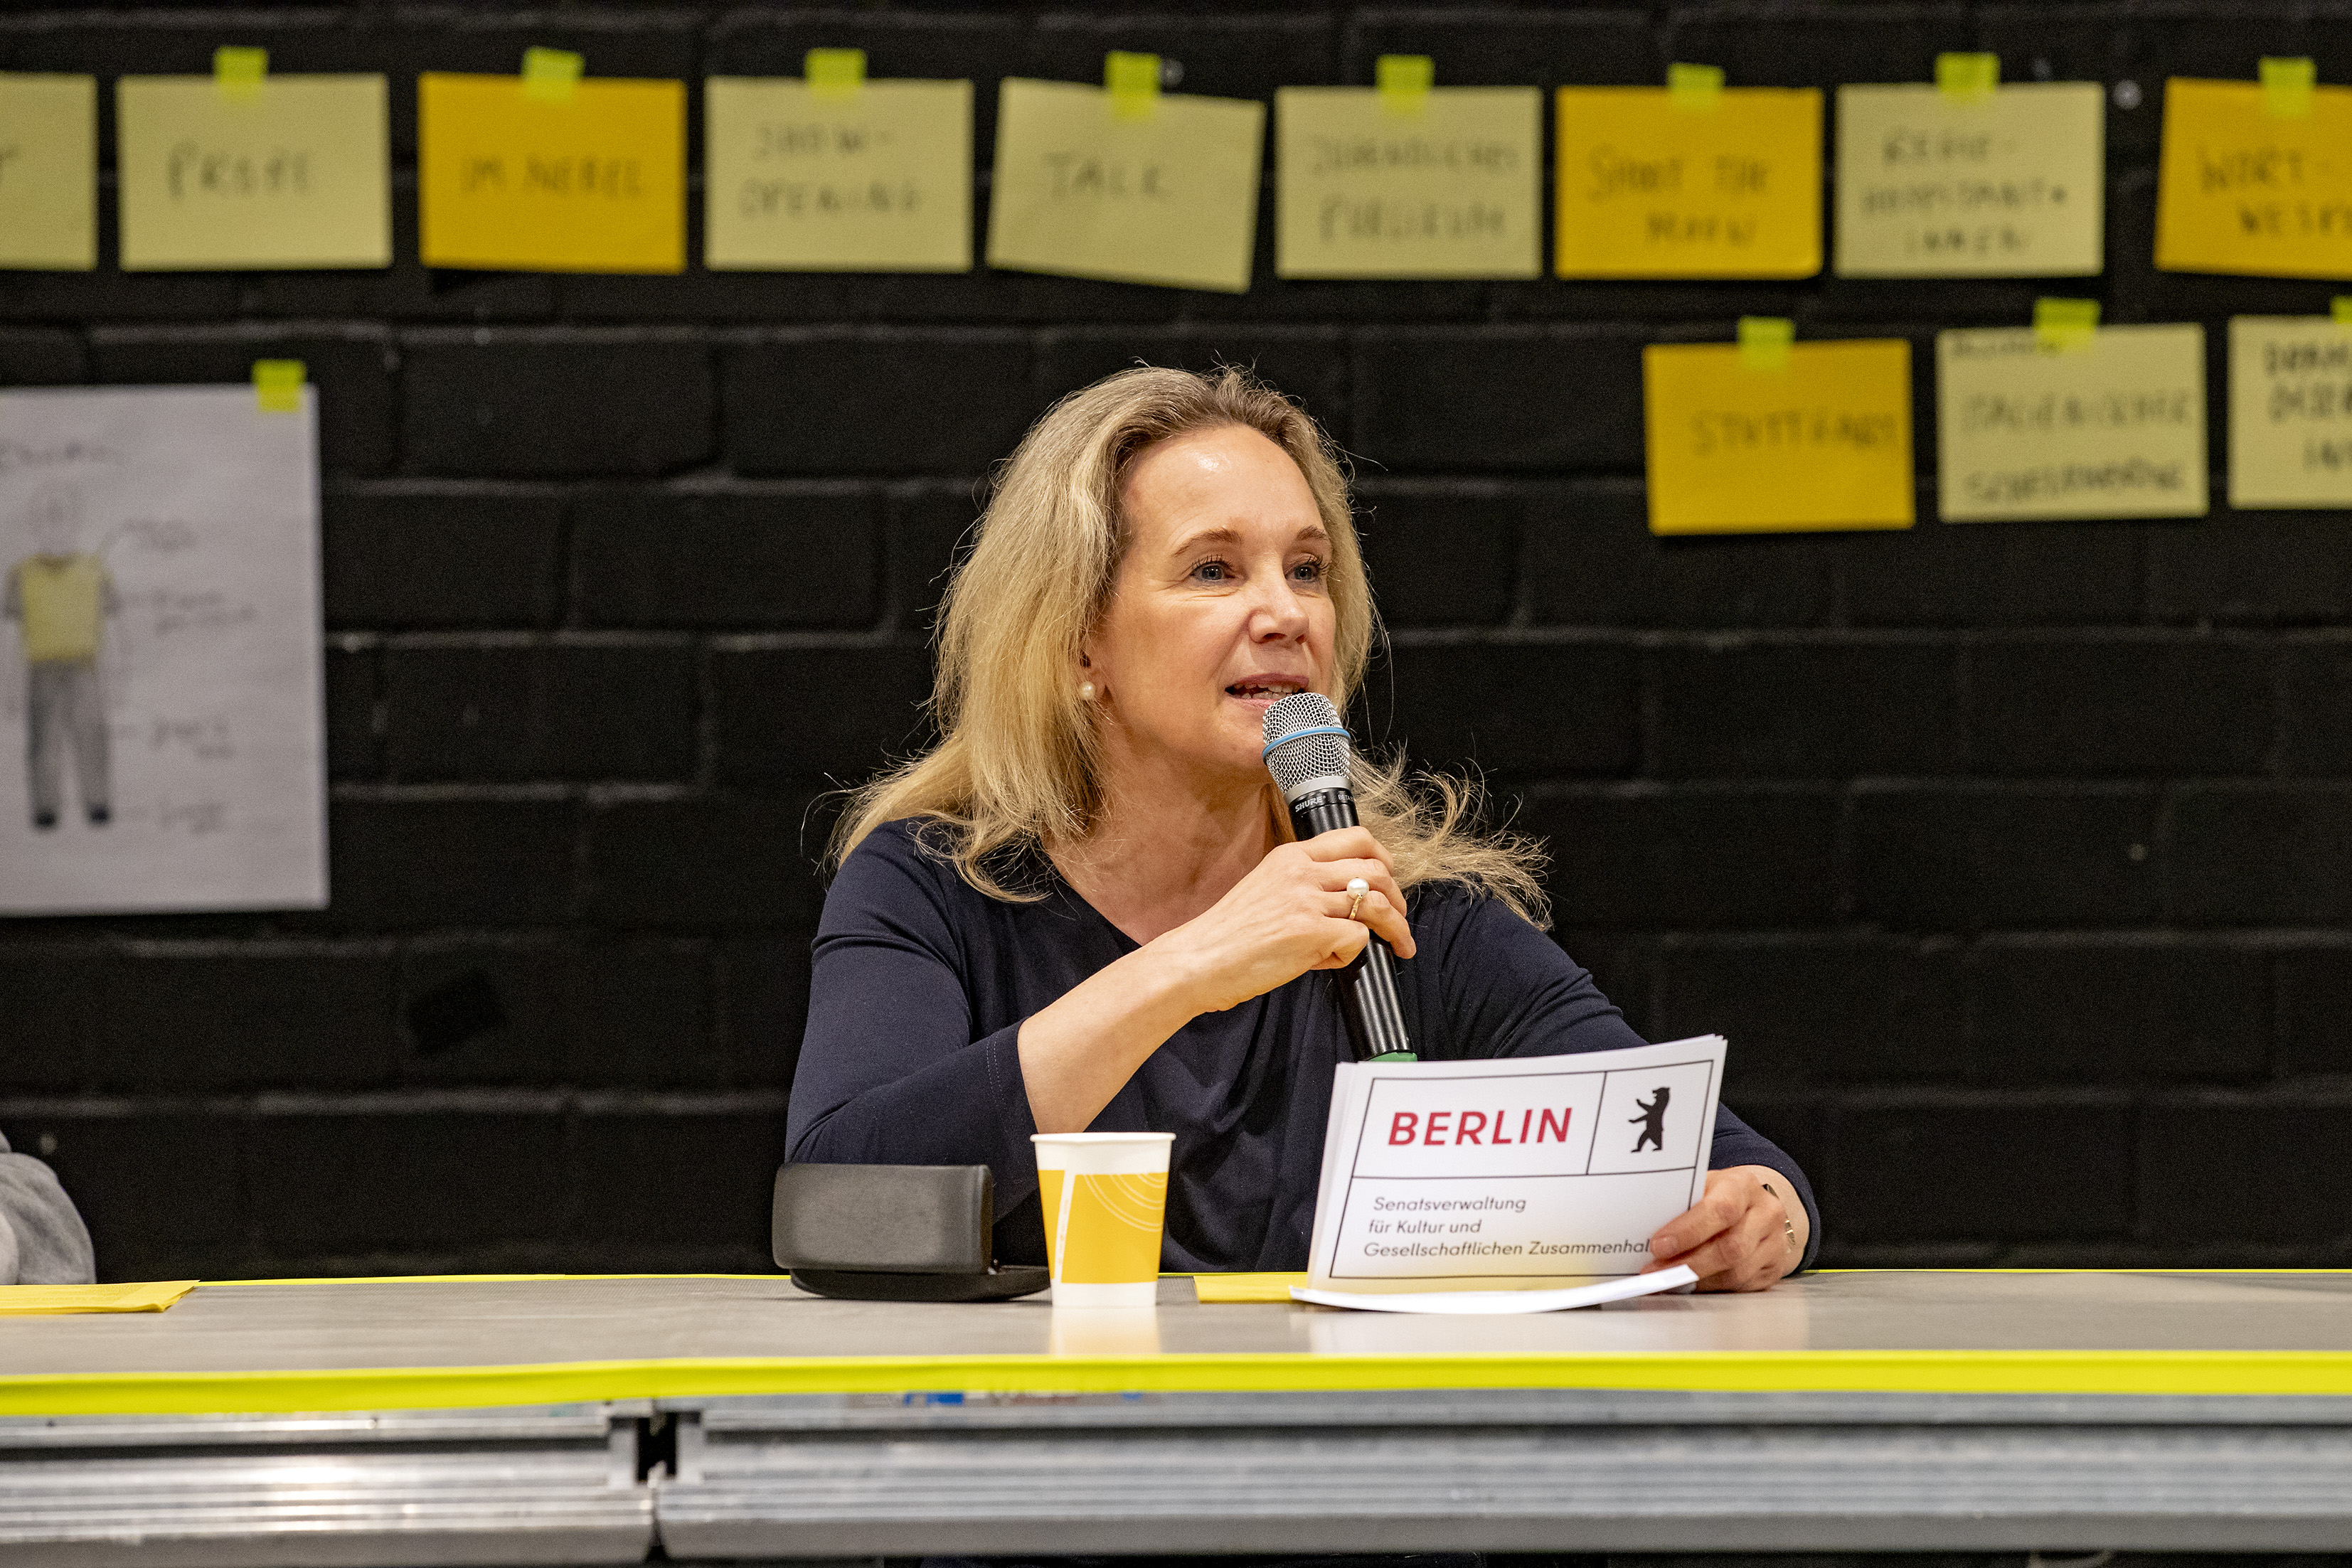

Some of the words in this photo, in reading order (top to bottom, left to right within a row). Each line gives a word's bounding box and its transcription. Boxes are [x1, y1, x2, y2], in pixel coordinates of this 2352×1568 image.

[1042, 150, 1172, 199] TALK
[1295, 796, 1323, 813] SHURE
[1388, 1107, 1572, 1146] BERLIN
[1373, 1196, 1526, 1213] Senatsverwaltung
[1368, 1219, 1392, 1234] für
[1397, 1219, 1444, 1234] Kultur
[1449, 1219, 1482, 1234] und
[1364, 1241, 1523, 1257] Gesellschaftlichen
[1528, 1239, 1650, 1256] Zusammenhal
